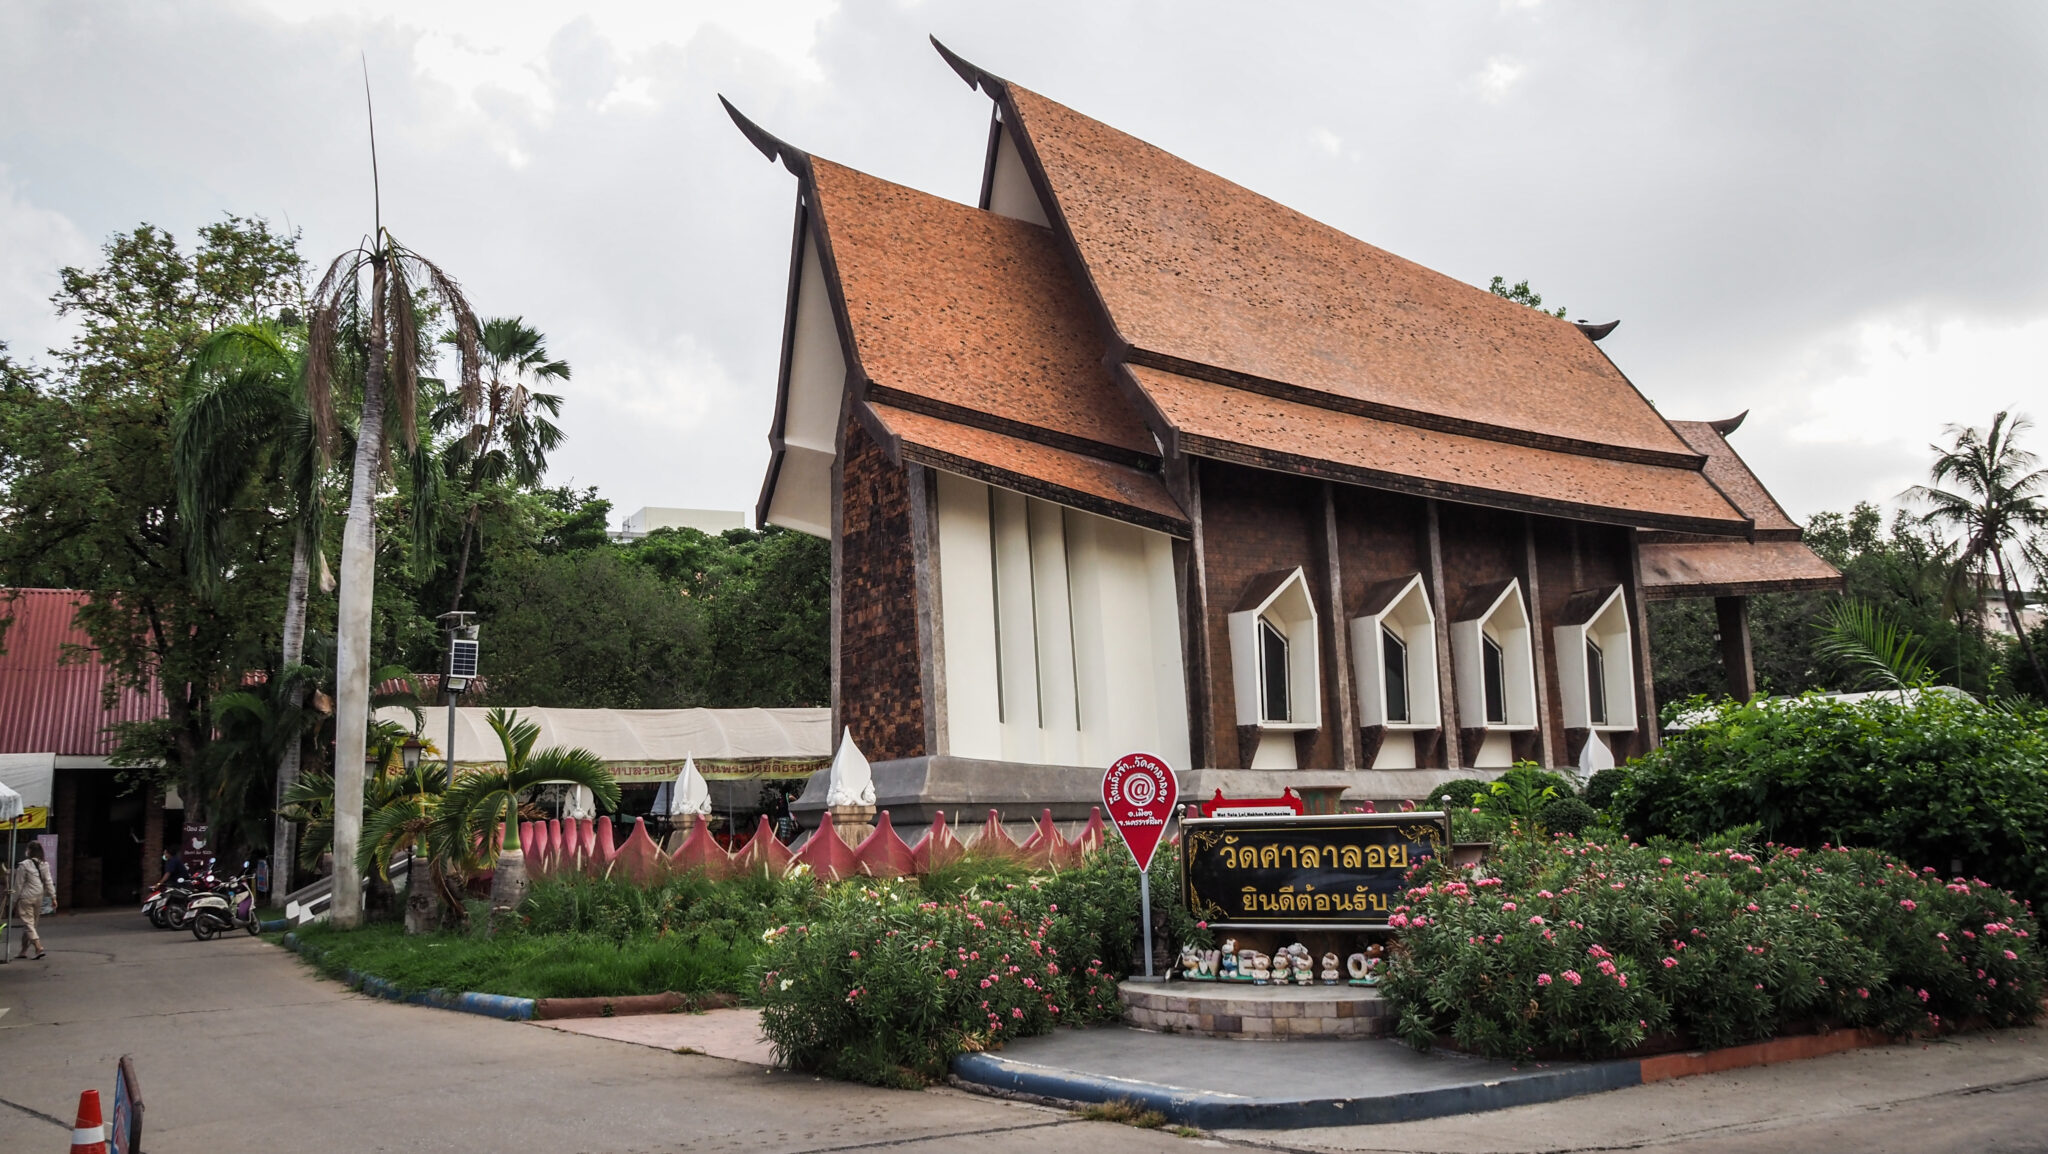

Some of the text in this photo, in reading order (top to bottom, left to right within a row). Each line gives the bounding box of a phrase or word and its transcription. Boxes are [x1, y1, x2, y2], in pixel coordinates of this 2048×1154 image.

[1219, 835, 1408, 869] วัดศาลาลอย
[1241, 883, 1387, 911] ยินดีต้อนรับ
